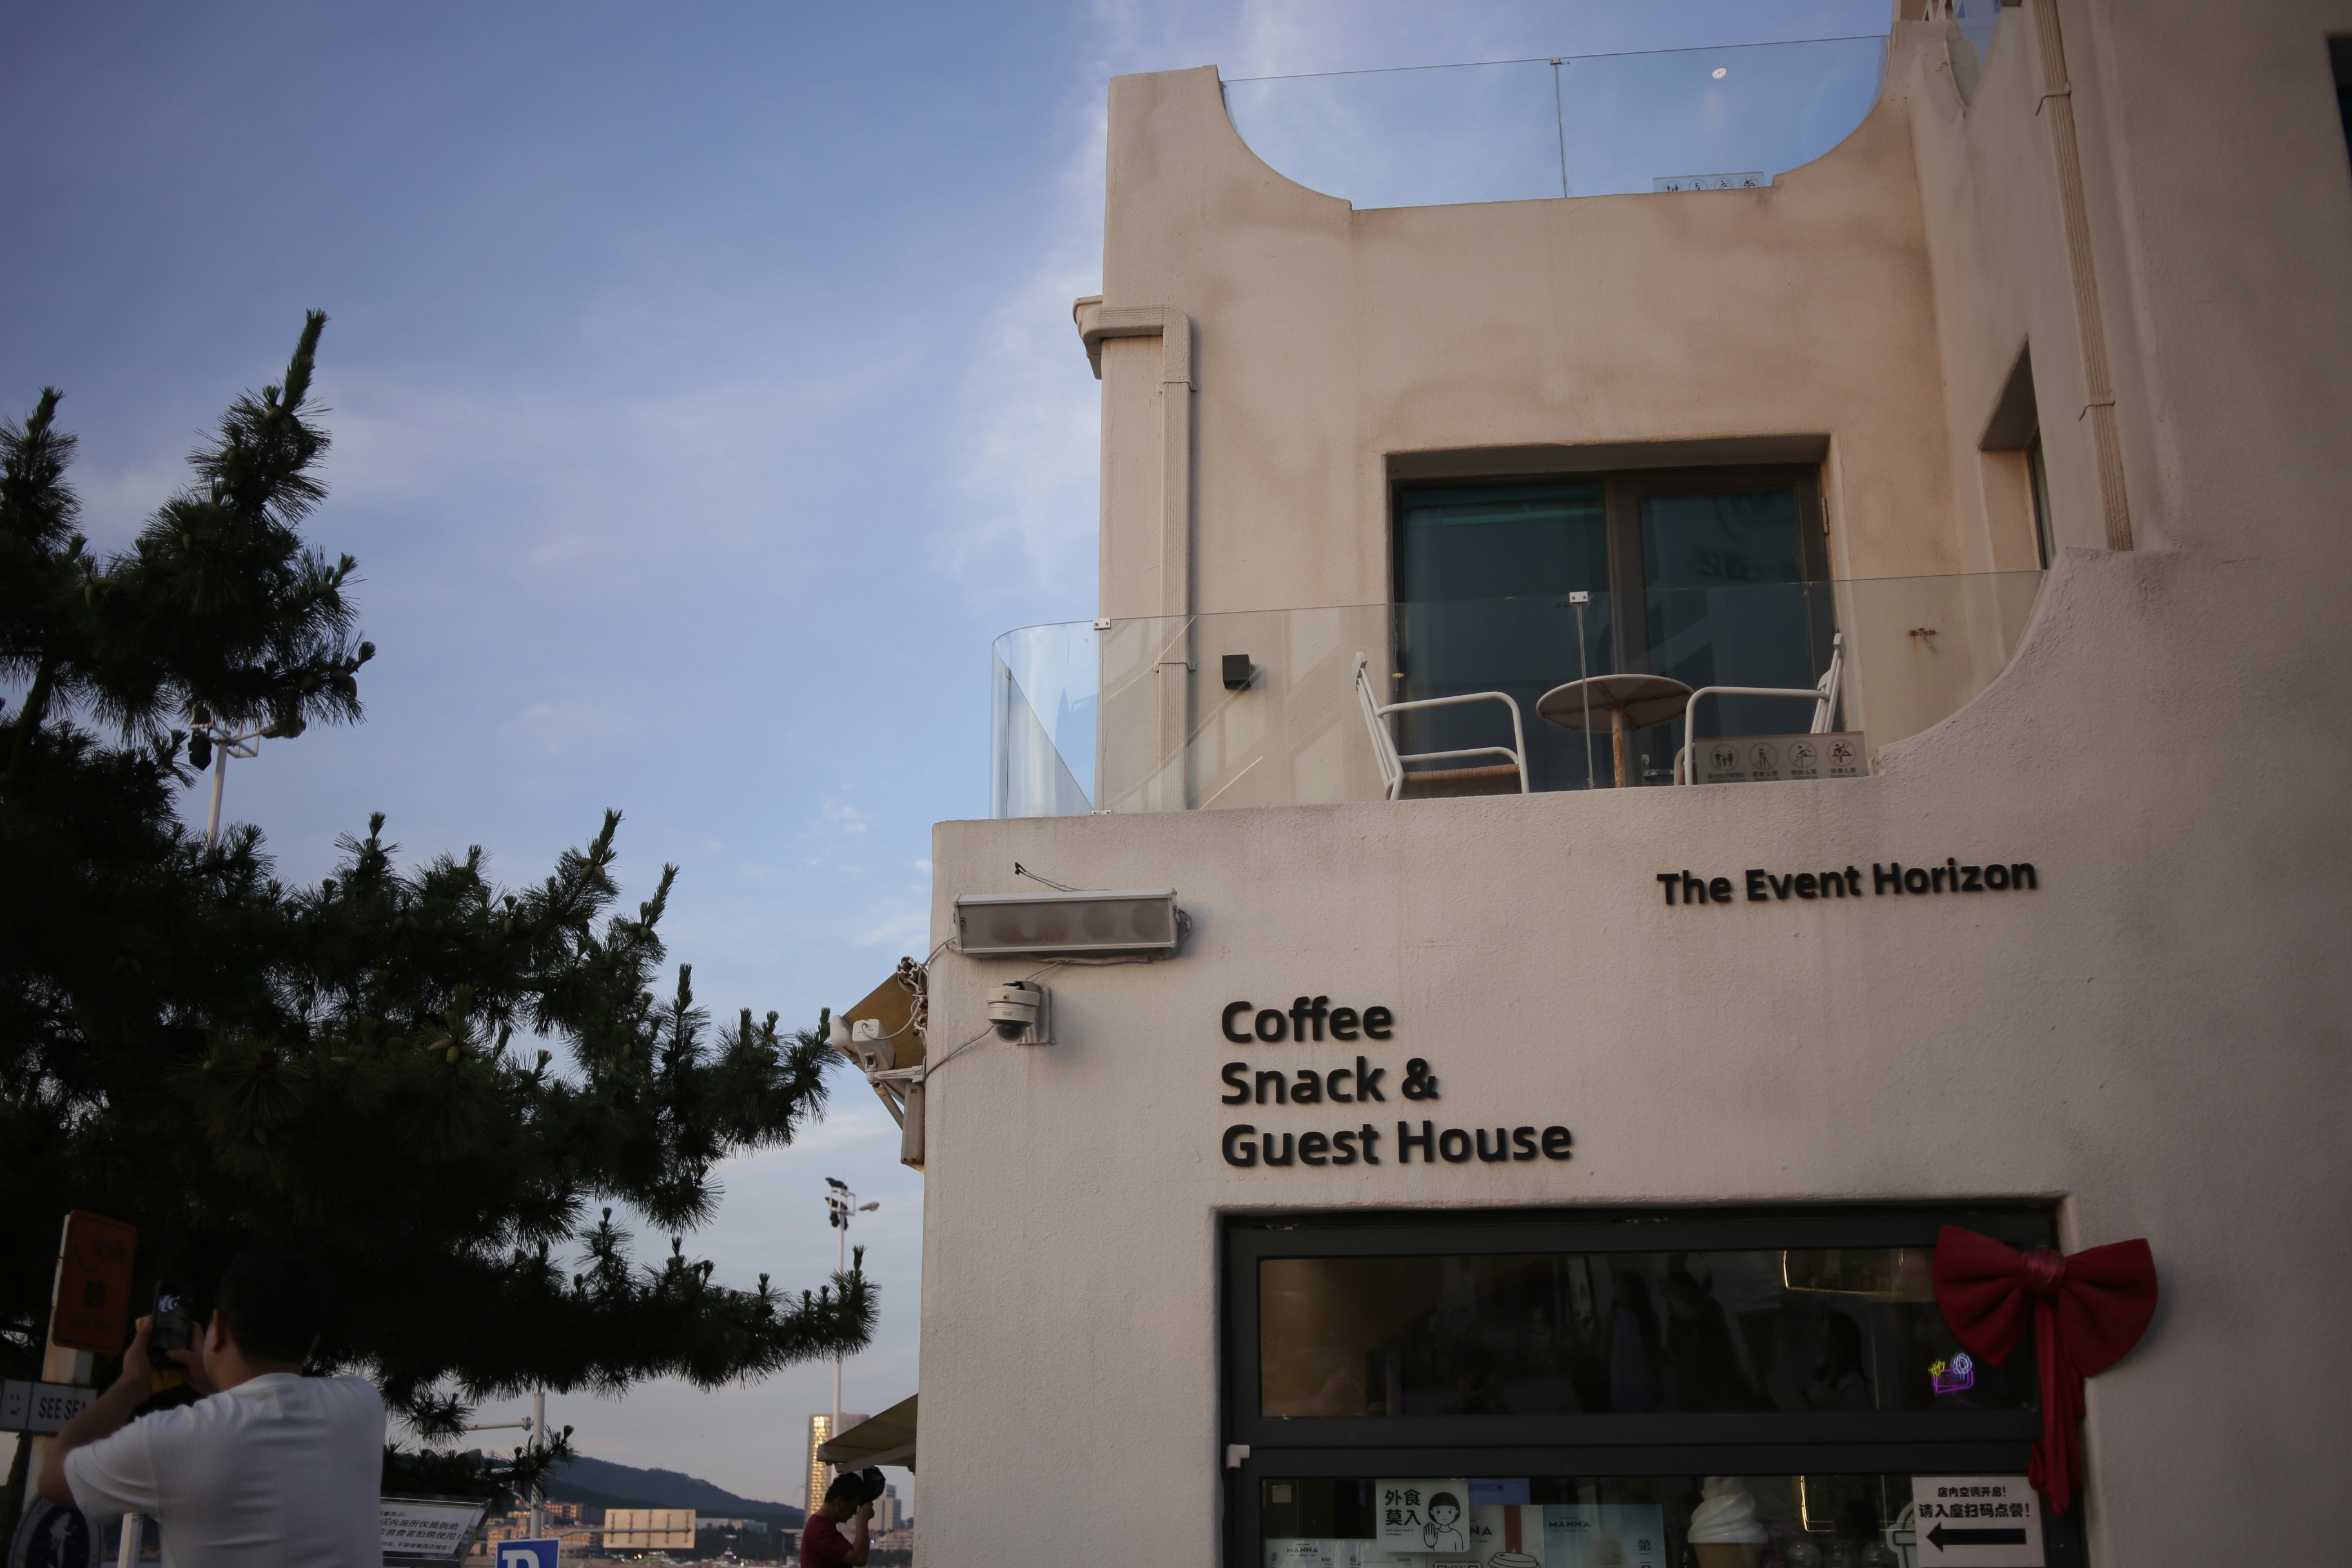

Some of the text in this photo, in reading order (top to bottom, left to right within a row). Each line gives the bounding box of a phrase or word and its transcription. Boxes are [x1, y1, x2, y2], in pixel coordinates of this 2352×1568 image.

[1657, 858, 2037, 905] The Event Horizon
[1222, 995, 1392, 1043] Coffee
[1221, 1056, 1439, 1104] Snack &
[1222, 1120, 1572, 1166] Guest House
[39, 1396, 63, 1419] SEE
[1385, 1489, 1421, 1506] 外食
[1937, 1486, 2006, 1498] 店内空调开启！
[1386, 1509, 1422, 1526] 莫入
[1919, 1503, 2030, 1518] 请入座扫码点餐！
